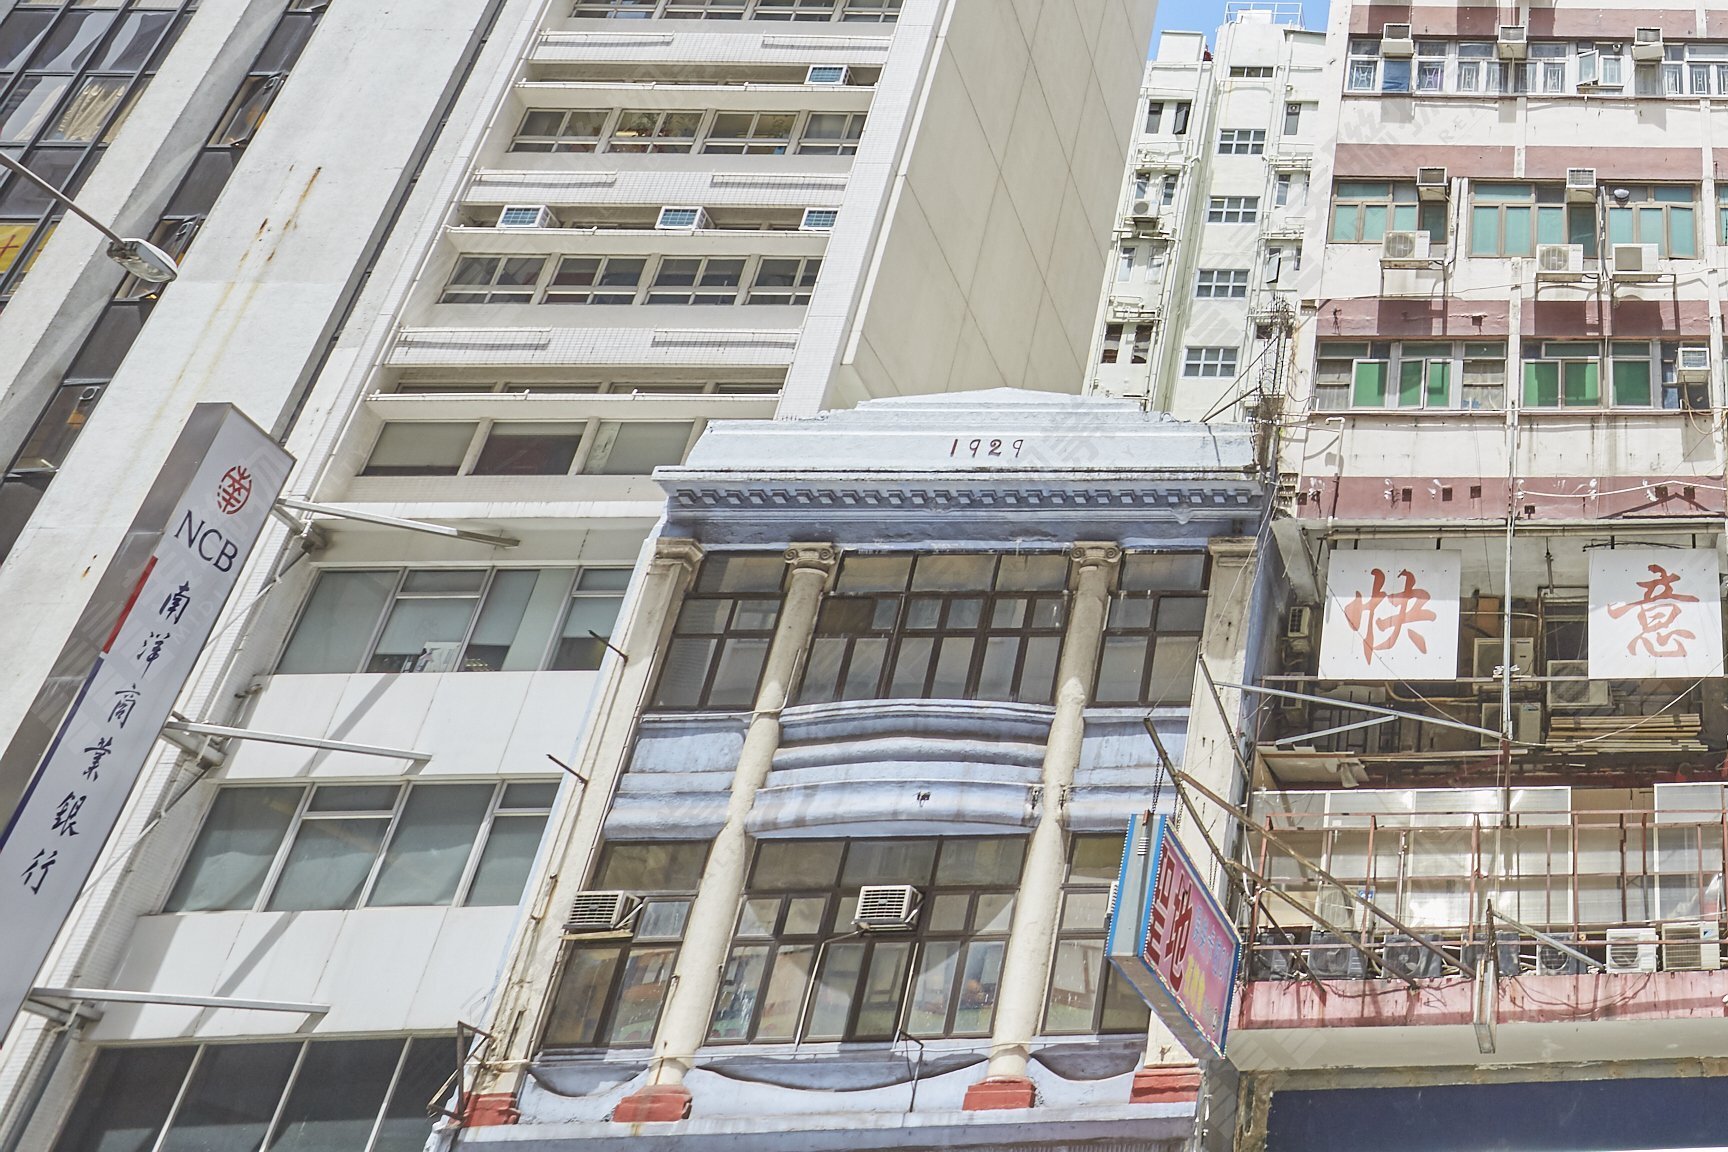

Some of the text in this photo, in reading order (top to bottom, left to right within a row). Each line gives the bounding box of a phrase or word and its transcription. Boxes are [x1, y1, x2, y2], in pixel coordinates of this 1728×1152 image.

[949, 438, 1024, 459] 1929
[173, 509, 239, 575] NCB
[1344, 567, 1437, 666] 快
[1607, 563, 1700, 658] 意
[20, 580, 191, 895] 南洋商業銀行
